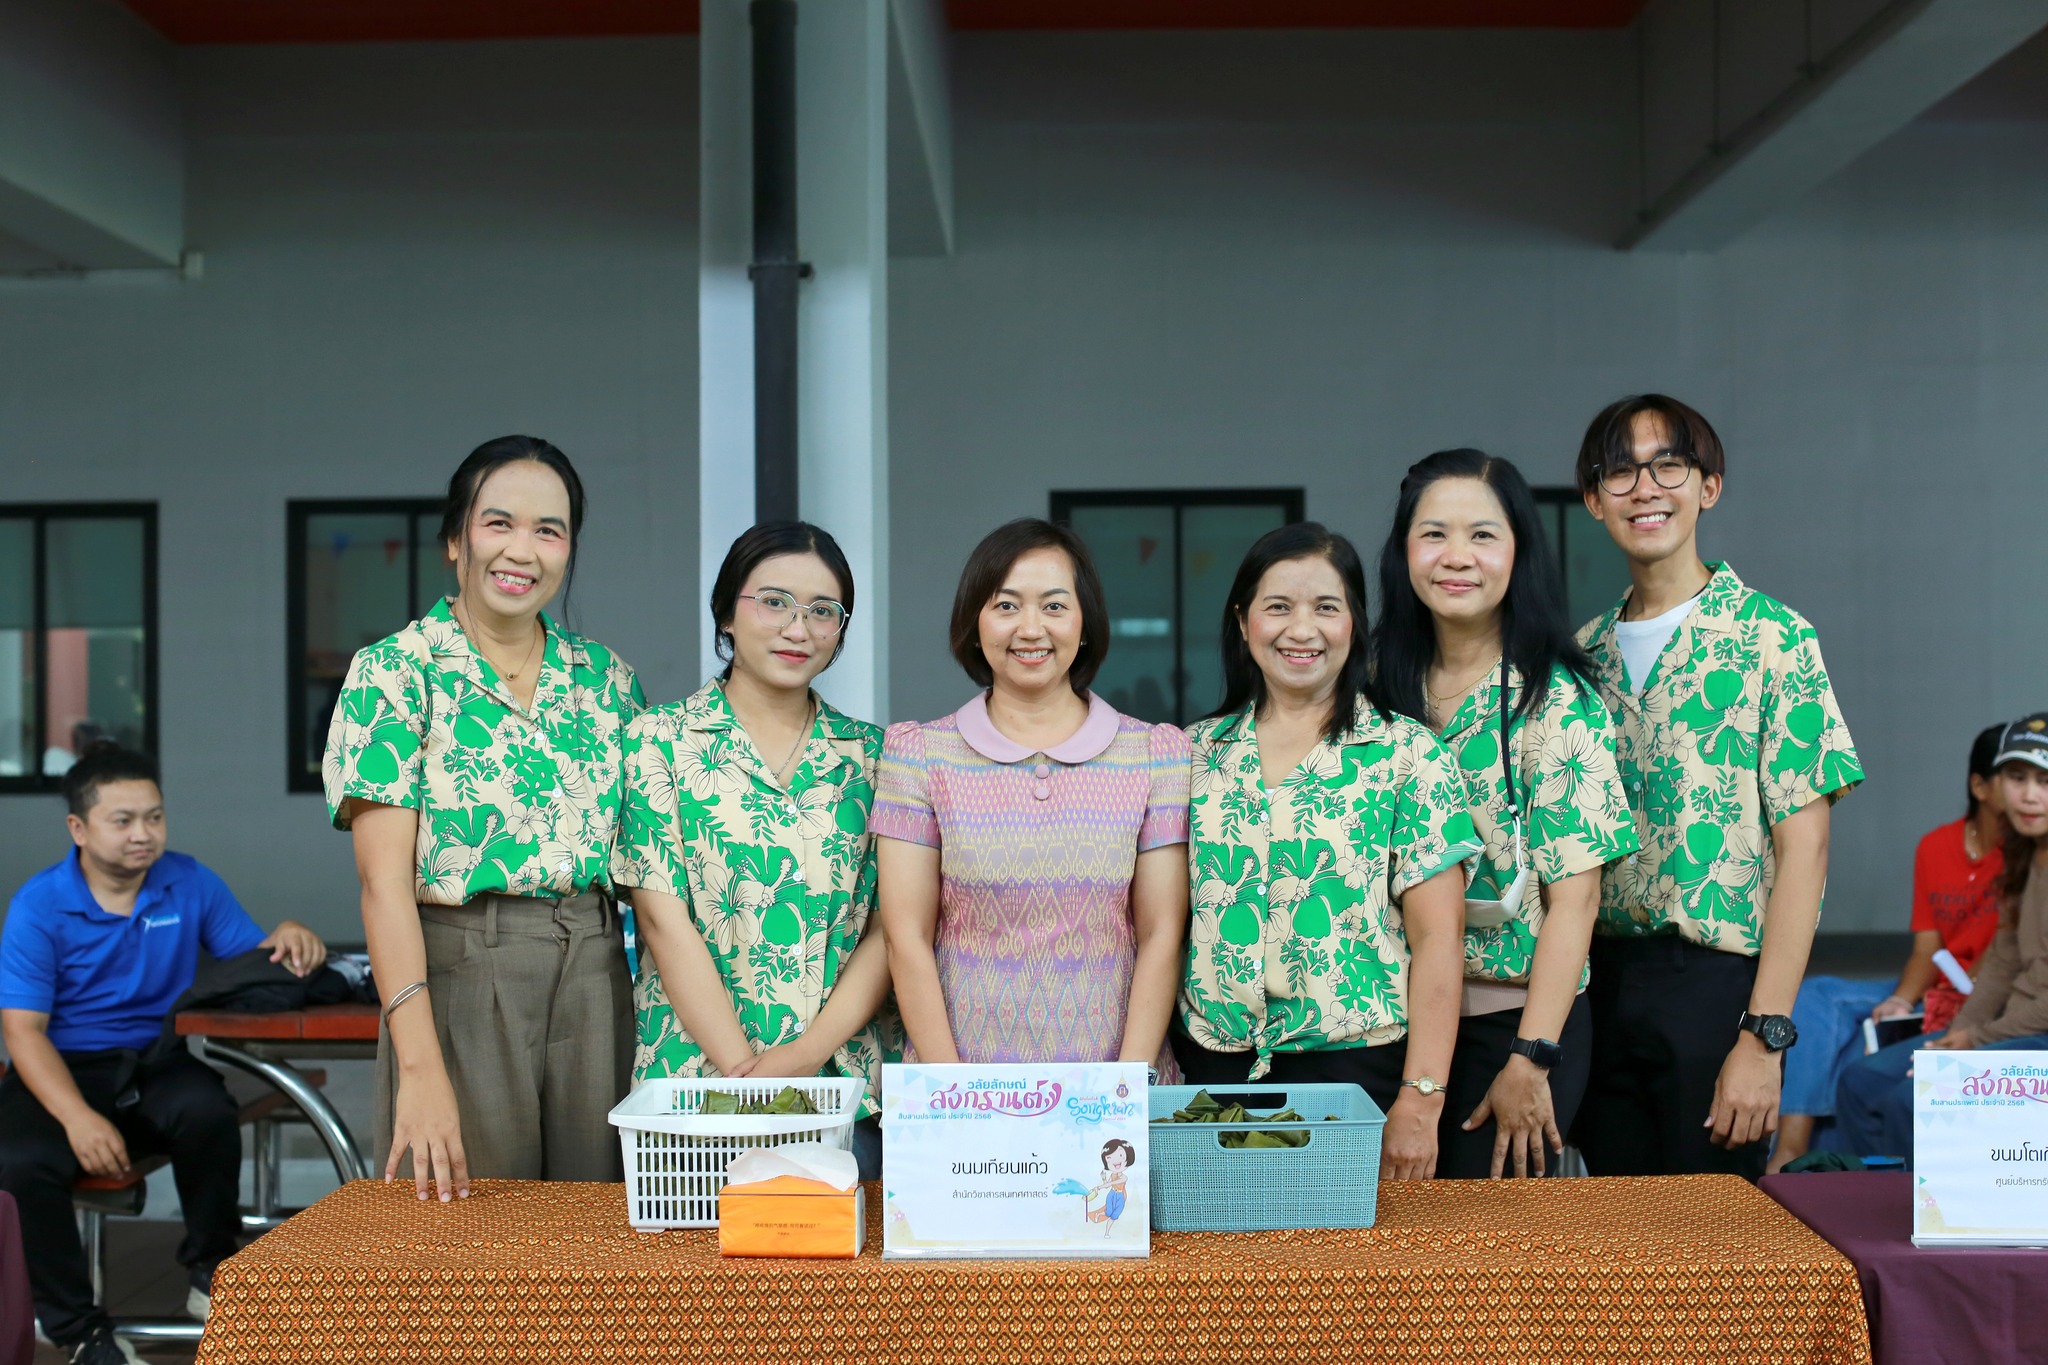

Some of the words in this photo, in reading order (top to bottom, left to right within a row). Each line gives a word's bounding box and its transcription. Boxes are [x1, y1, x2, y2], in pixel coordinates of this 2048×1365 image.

[967, 1078, 1027, 1090] วลัยลักษณ์
[1980, 1098, 2006, 1106] ประจำปี
[948, 1112, 973, 1120] ประจำปี
[1067, 1095, 1135, 1126] Songkran
[951, 1152, 1048, 1175] ขนมเทียนแก้ว
[1995, 1174, 2048, 1188] ศูนย์บริหารทรั
[952, 1186, 1048, 1199] สำนักวิชาสารสนเทศศาสตร์
